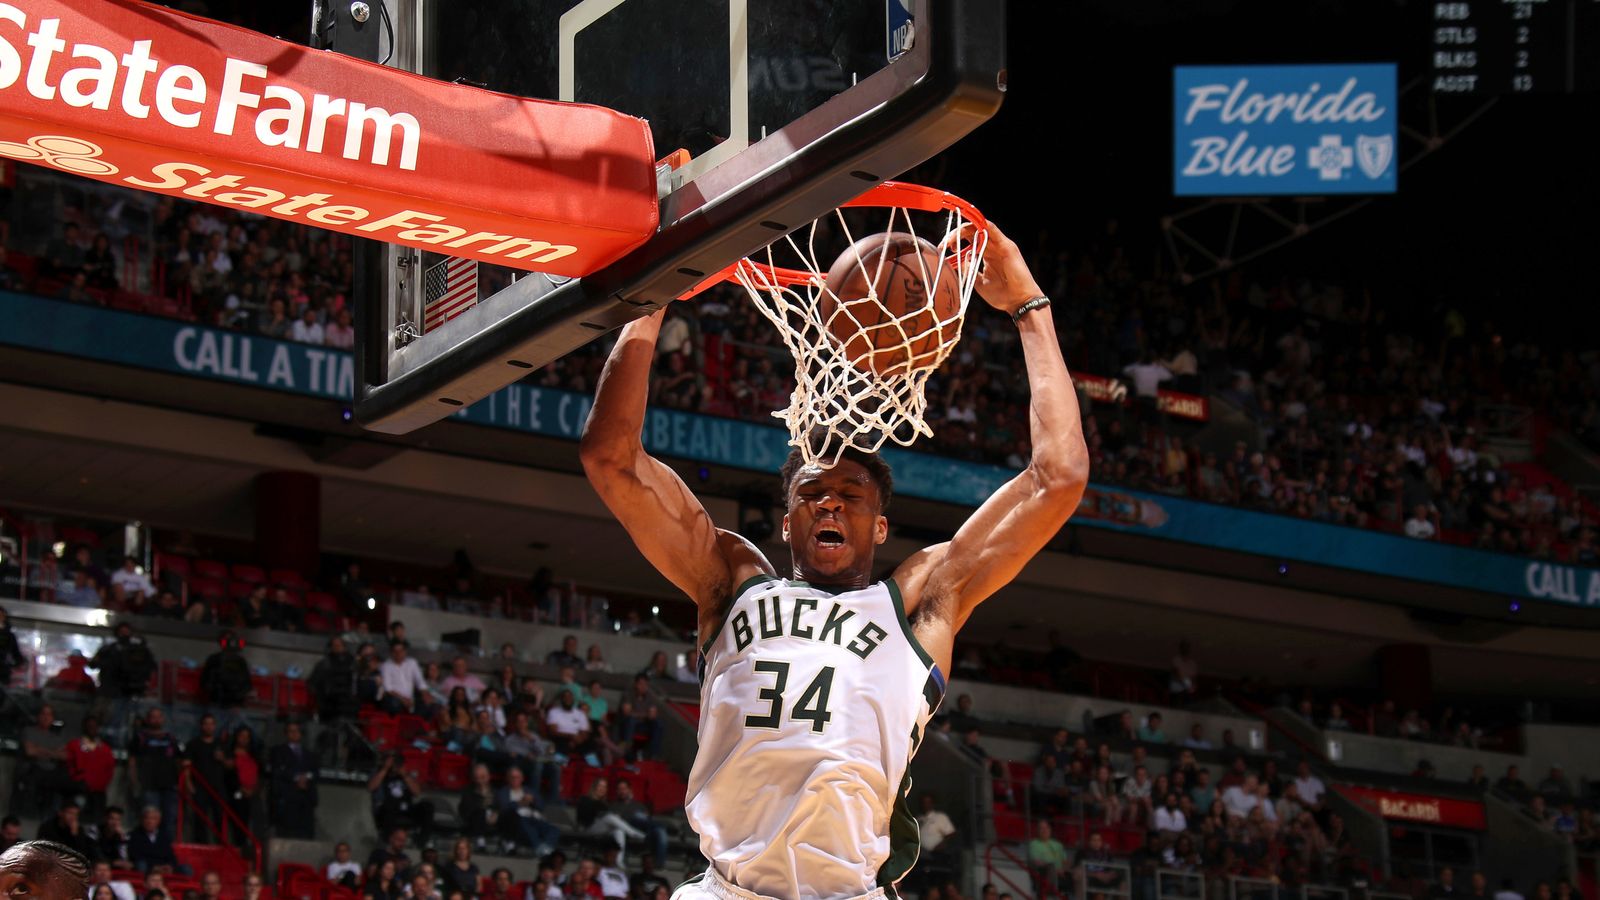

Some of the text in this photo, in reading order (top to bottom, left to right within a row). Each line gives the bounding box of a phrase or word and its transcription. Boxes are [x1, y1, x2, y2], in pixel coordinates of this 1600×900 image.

[1434, 2, 1471, 20] REB
[893, 25, 913, 54] NB
[1433, 26, 1530, 44] STLS 2
[1433, 51, 1530, 68] BLKS 2
[1184, 77, 1387, 125] Florida
[1432, 75, 1534, 92] ASST 13
[214, 58, 421, 171] Farm
[1181, 130, 1296, 177] Blue
[122, 163, 577, 264] State Farm
[173, 327, 259, 382] CALL
[267, 343, 295, 388] A
[743, 426, 772, 466] IS
[1525, 561, 1580, 603] CALL
[731, 595, 888, 661] BUCKS
[744, 660, 836, 733] 34
